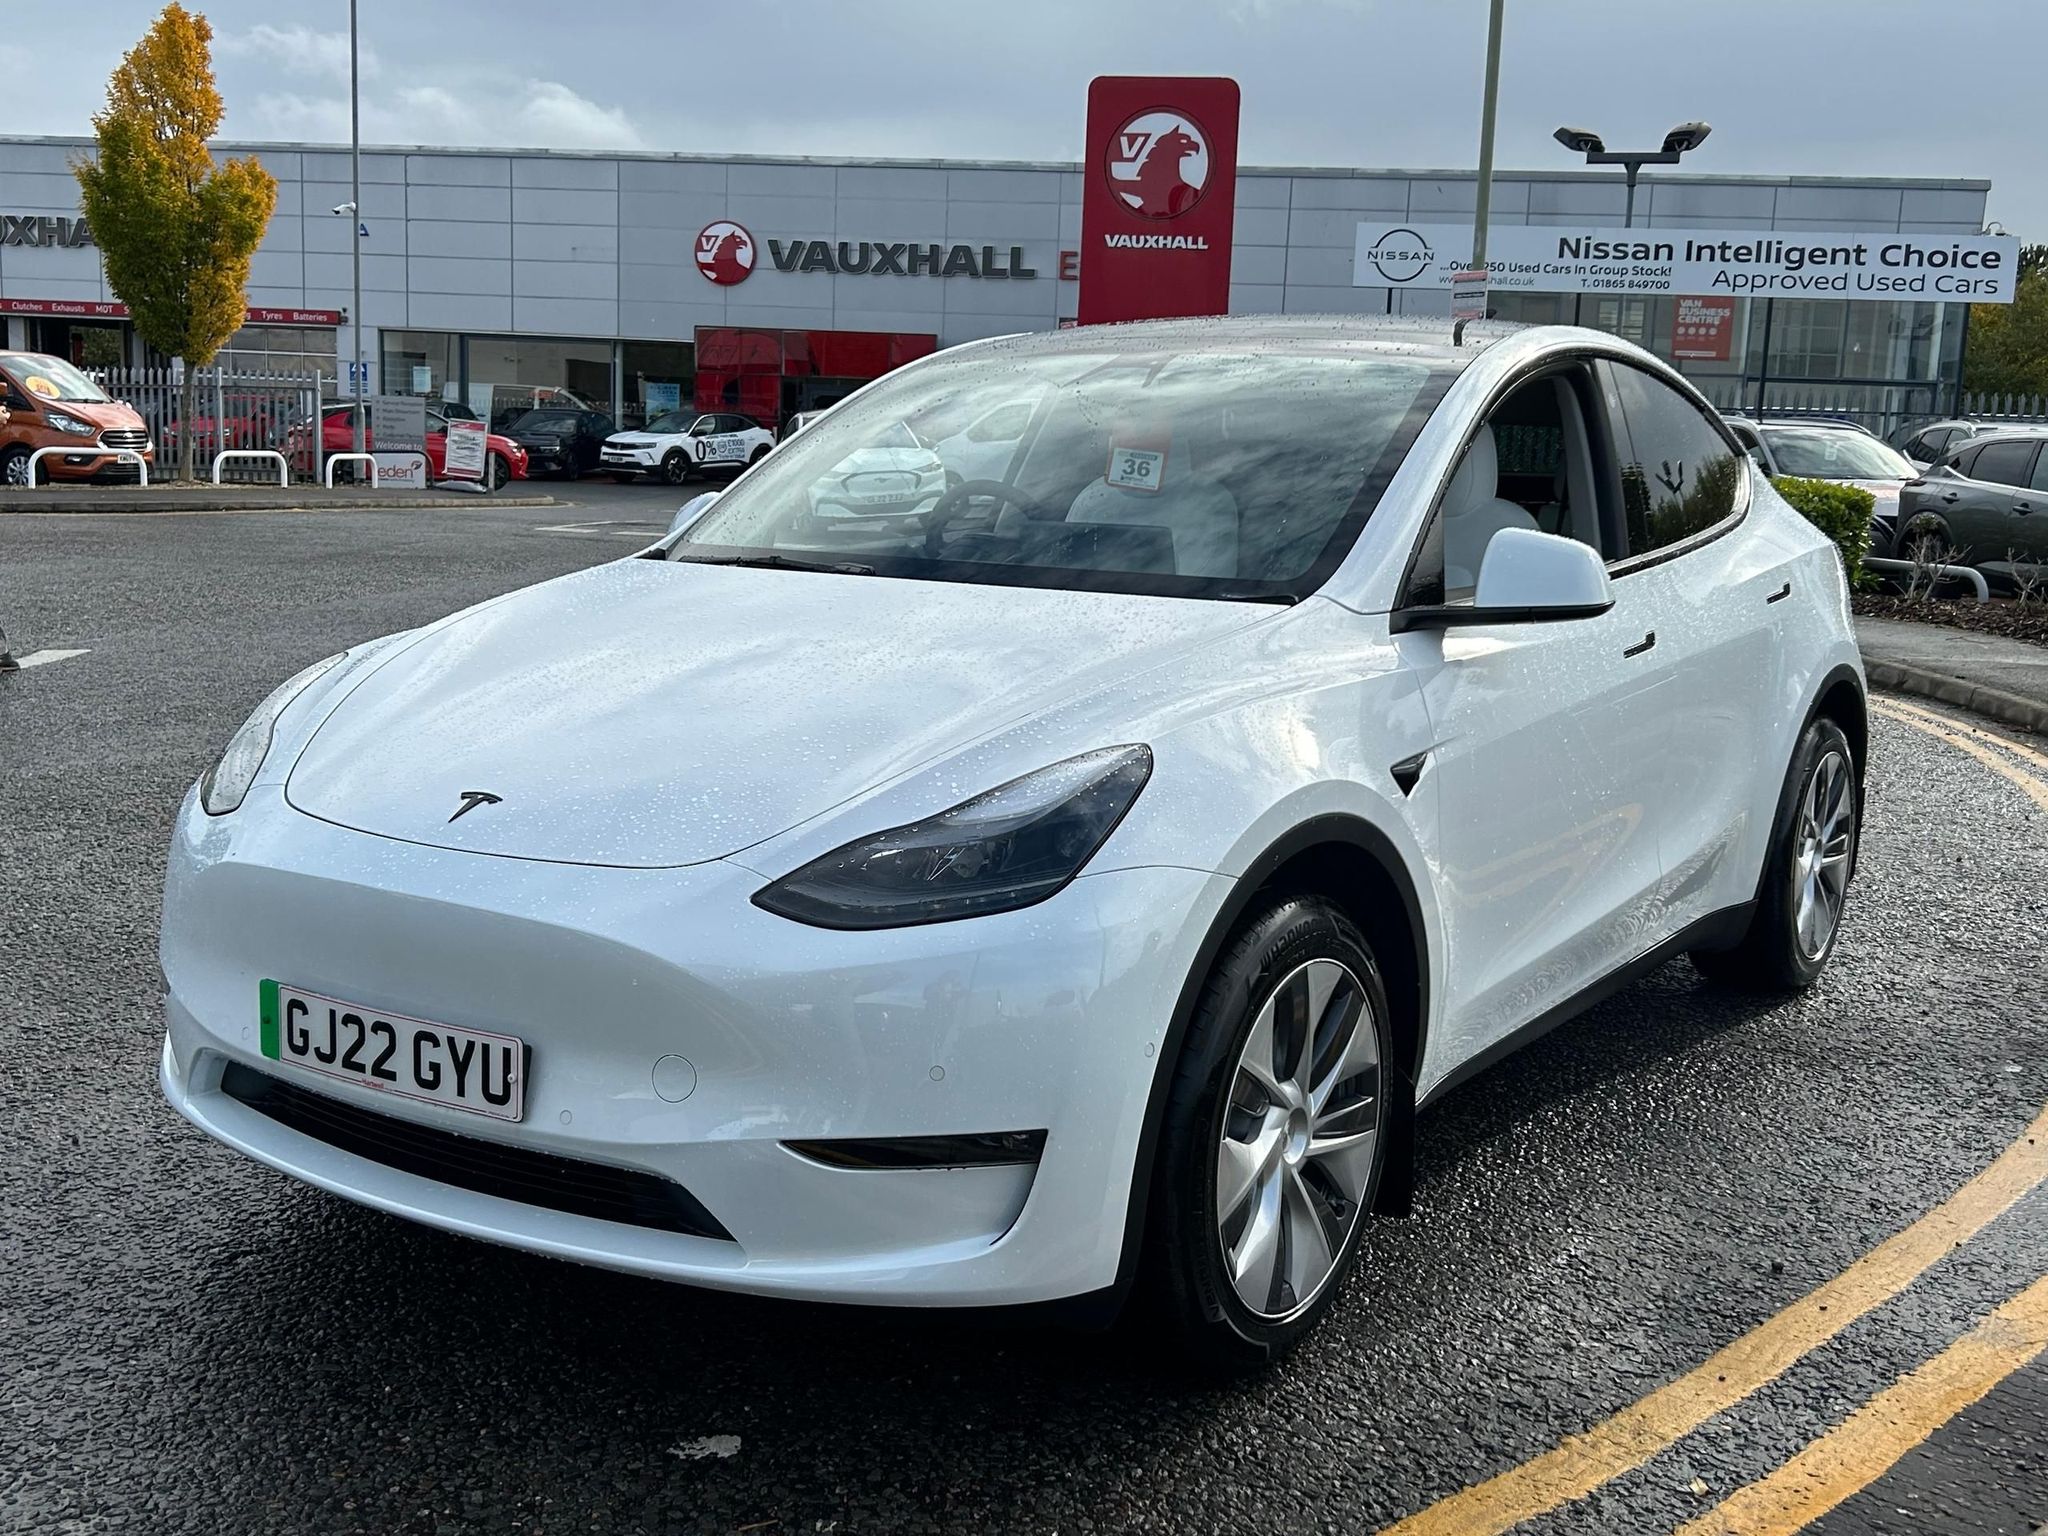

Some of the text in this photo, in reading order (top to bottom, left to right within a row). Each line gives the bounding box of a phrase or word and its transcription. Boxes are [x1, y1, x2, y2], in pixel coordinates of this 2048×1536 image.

[1104, 234, 1209, 250] VAUXHALL
[767, 239, 1036, 279] VAUXHALL
[1367, 250, 1434, 261] NISSAN
[1558, 236, 2001, 271] Nissan Intelligent Choice
[1509, 263, 1540, 273] Used
[1543, 264, 1571, 275] Cars
[1574, 265, 1586, 275] In
[1589, 265, 1629, 278] Group
[1631, 266, 1672, 277] Stock!
[1581, 279, 1670, 289] T. 01865 849700
[1712, 270, 1998, 294] Approved Used Cars
[1680, 299, 1702, 307] VAN
[11, 301, 43, 311] Clutches
[51, 303, 85, 313] Exhausts
[95, 305, 113, 314] MOT
[261, 311, 284, 321] Tyres
[293, 312, 328, 322] Batteries
[1679, 308, 1730, 316] BUSINESS
[1678, 316, 1720, 325] CENTRE
[375, 441, 412, 450] Welcome
[378, 465, 414, 479] eden
[1122, 458, 1151, 477] 36
[286, 998, 512, 1106] GJ22 GYU
